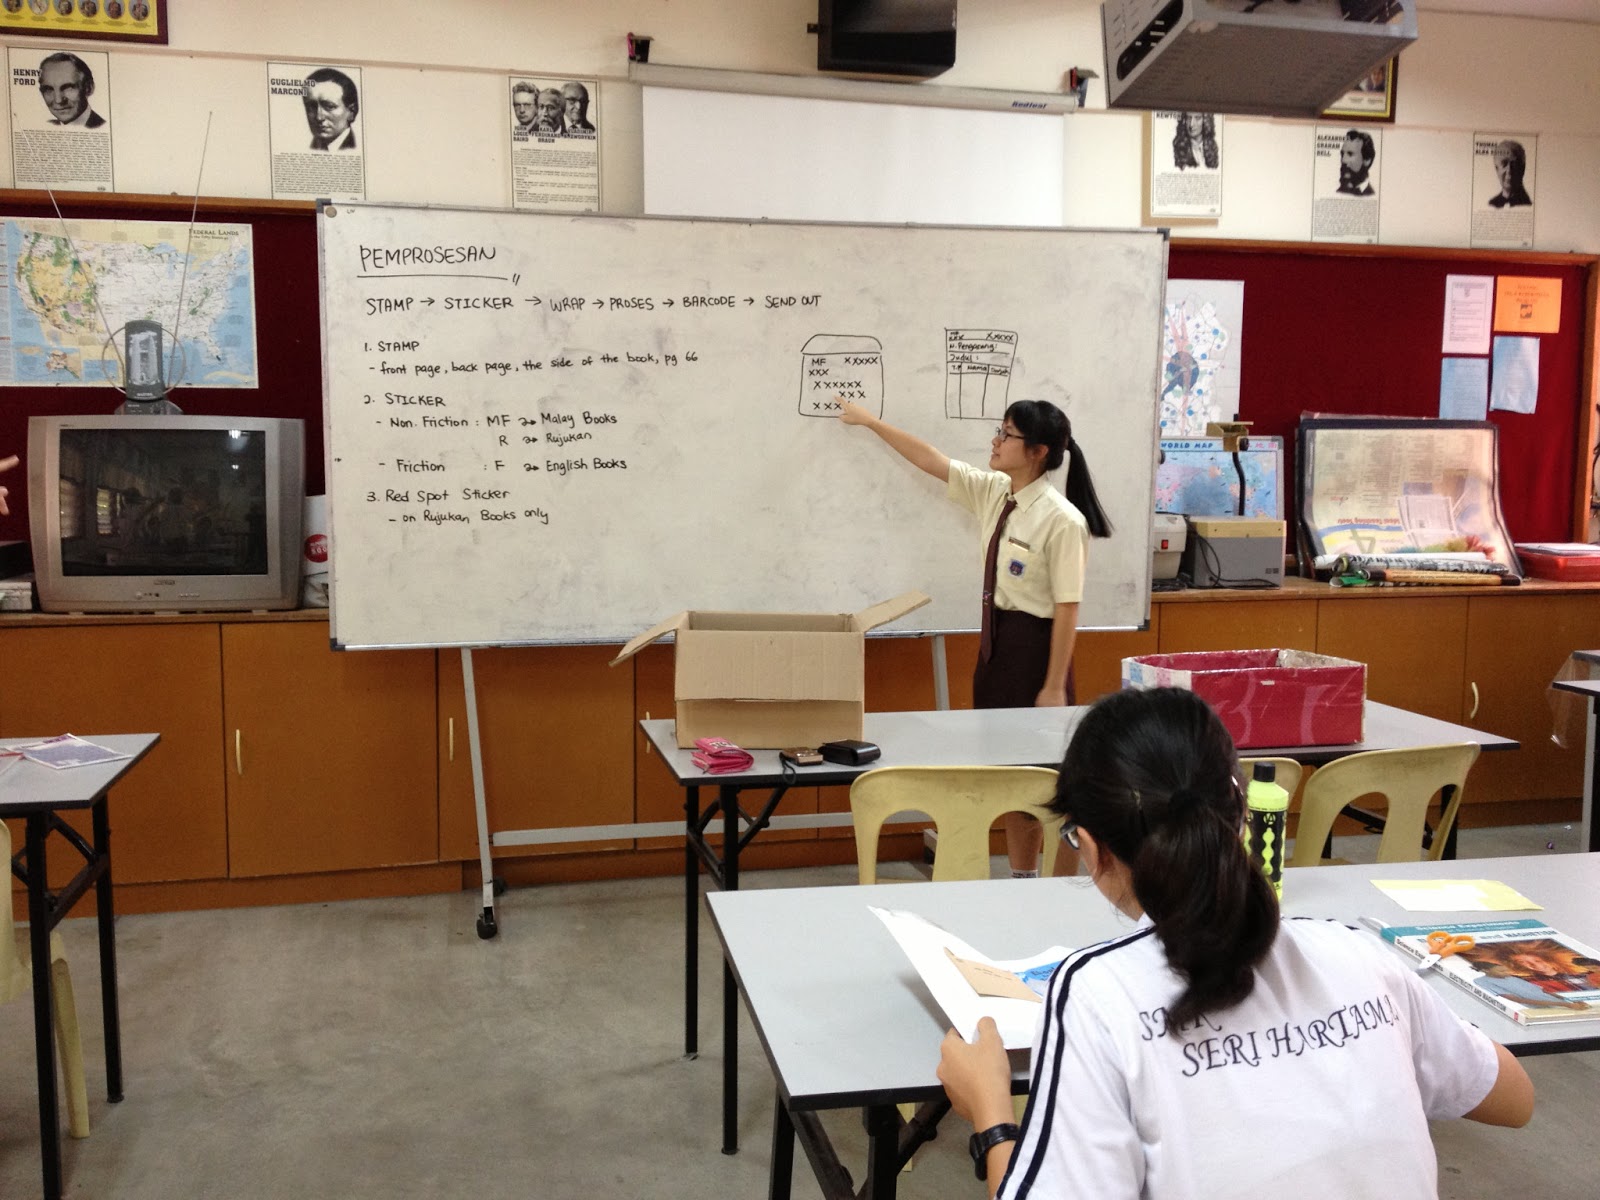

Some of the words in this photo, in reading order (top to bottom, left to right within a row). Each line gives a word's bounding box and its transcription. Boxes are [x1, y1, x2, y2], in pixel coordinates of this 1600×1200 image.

[13, 68, 41, 77] HENRY
[13, 77, 36, 86] FORD
[270, 78, 316, 88] GUGLIELMO
[271, 87, 308, 96] MARCONI
[359, 244, 497, 273] PEMPROSESAN
[365, 296, 415, 317] STAMP
[443, 296, 515, 311] STICKER
[549, 296, 586, 313] WRAP
[609, 296, 655, 312] PROSES
[682, 295, 736, 308] BARCODE
[764, 294, 797, 310] SEND
[800, 294, 822, 308] OUT
[377, 340, 421, 353] STAMP
[379, 360, 407, 376] front
[450, 360, 479, 373] back
[521, 359, 543, 372] the
[550, 356, 574, 369] side
[581, 355, 594, 367] of
[599, 352, 620, 364] the
[663, 353, 678, 367] pg
[684, 350, 699, 362] 66
[812, 358, 826, 366] MF
[384, 391, 447, 408] STICKER
[421, 415, 469, 428] Friction
[485, 414, 512, 428] MF
[539, 411, 576, 430] Malay
[581, 410, 618, 425] Books
[498, 434, 509, 447] R
[545, 431, 593, 448] Rujukan
[395, 458, 446, 473] Friction
[493, 459, 506, 472] F
[545, 457, 589, 477] English
[592, 456, 628, 471] Books
[385, 488, 410, 503] Red
[416, 489, 450, 506] Spot
[462, 487, 511, 501] Sticker
[402, 514, 417, 523] on
[423, 508, 470, 526] Rujukan
[479, 508, 517, 522] Books
[523, 507, 550, 526] only
[1181, 1030, 1262, 1077] SERI
